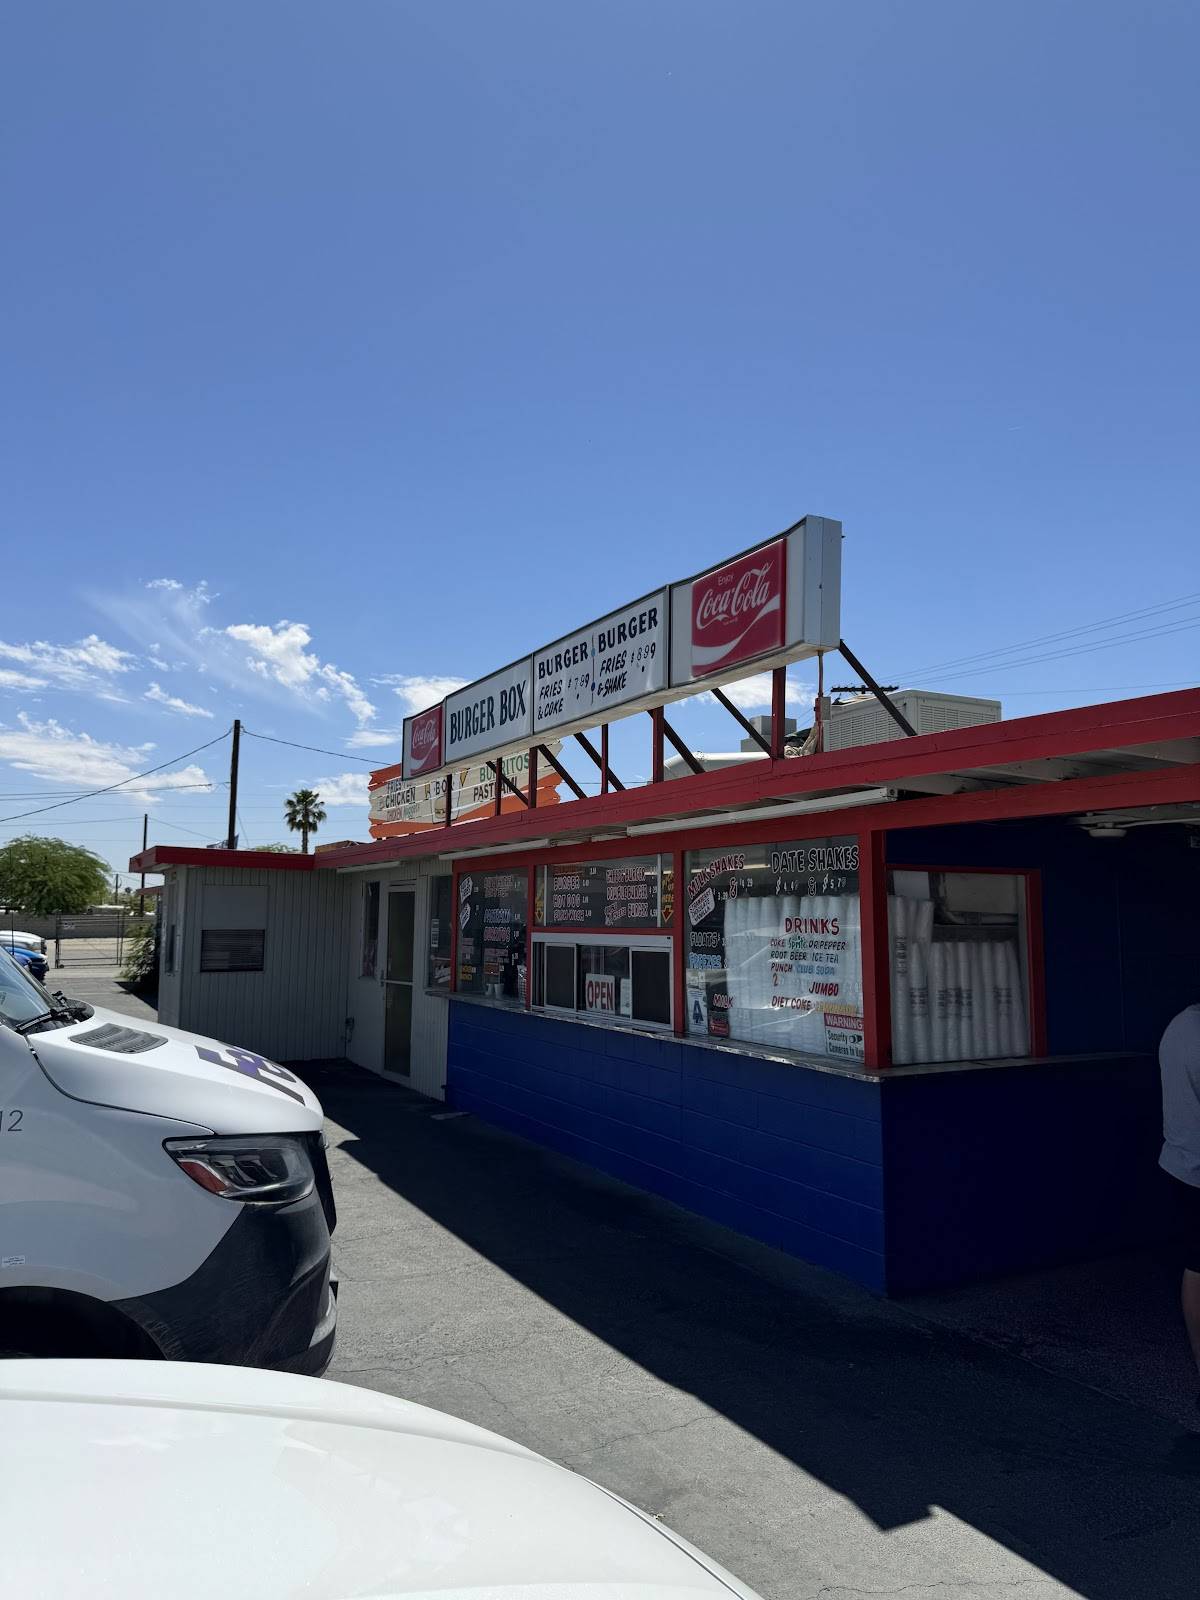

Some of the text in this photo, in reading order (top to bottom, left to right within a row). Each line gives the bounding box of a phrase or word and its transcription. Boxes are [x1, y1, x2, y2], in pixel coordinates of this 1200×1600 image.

[718, 574, 734, 586] Enjoy
[696, 560, 774, 630] Coca-Cola
[598, 607, 658, 653] BURGER
[538, 641, 588, 680] BURGER
[600, 650, 627, 677] FRIES
[539, 680, 562, 701] FRIES
[450, 680, 526, 744] BURGER BOX
[385, 787, 416, 808] CHICKEN
[771, 845, 860, 874] DATE SHAKES
[687, 853, 745, 899] MILK SHAKES
[785, 918, 840, 935] DRINKS
[690, 931, 718, 948] FLOATS
[771, 951, 787, 959] ROOT
[790, 951, 807, 960] BEER
[771, 963, 793, 973] PUNCH
[587, 981, 613, 1010] OPEN
[808, 982, 839, 997] JUMBO
[771, 995, 789, 1007] DIET
[791, 997, 811, 1011] COKE
[826, 1014, 863, 1030] WARNING
[827, 1029, 848, 1044] Security
